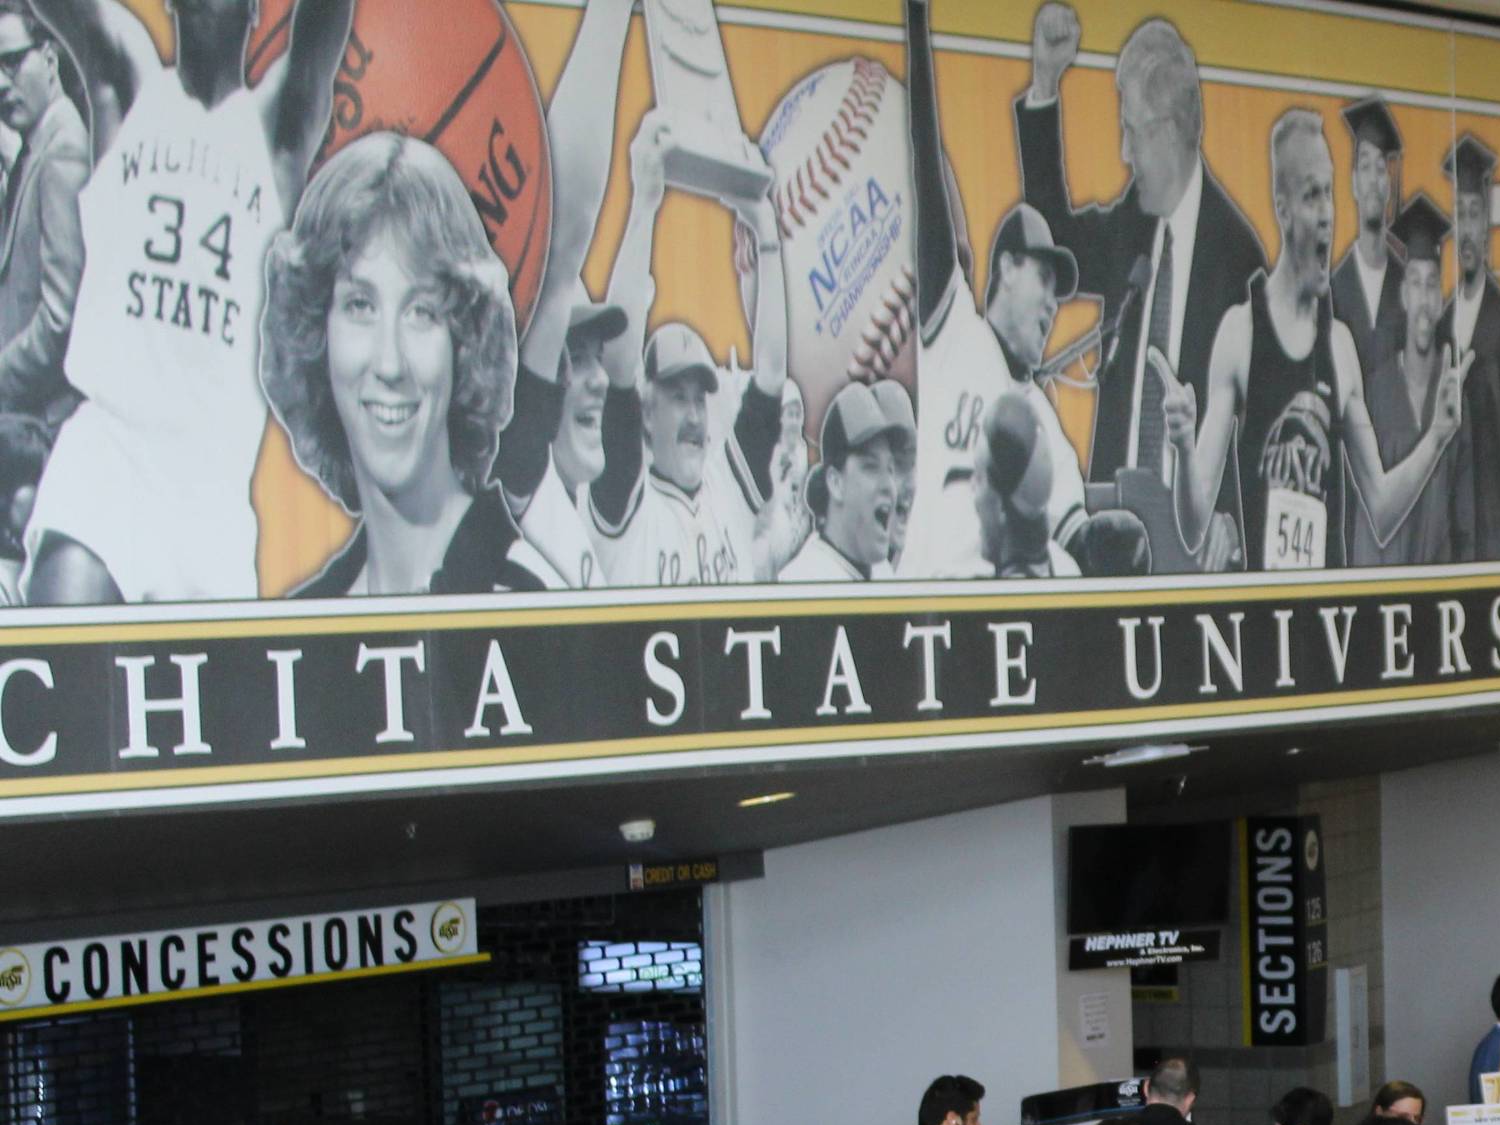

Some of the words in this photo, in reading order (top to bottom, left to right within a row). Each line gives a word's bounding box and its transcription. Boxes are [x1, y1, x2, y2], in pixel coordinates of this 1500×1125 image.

[143, 193, 233, 281] 34
[809, 177, 890, 313] NCAA
[126, 270, 242, 348] STATE
[1278, 511, 1314, 569] 544
[0, 638, 533, 766] CHITA
[642, 619, 1037, 727] STATE
[44, 909, 417, 1004] CONCESSIONS
[1085, 932, 1156, 952] HEPHNER
[1159, 929, 1180, 946] TV
[1255, 827, 1297, 1035] SECTIONS
